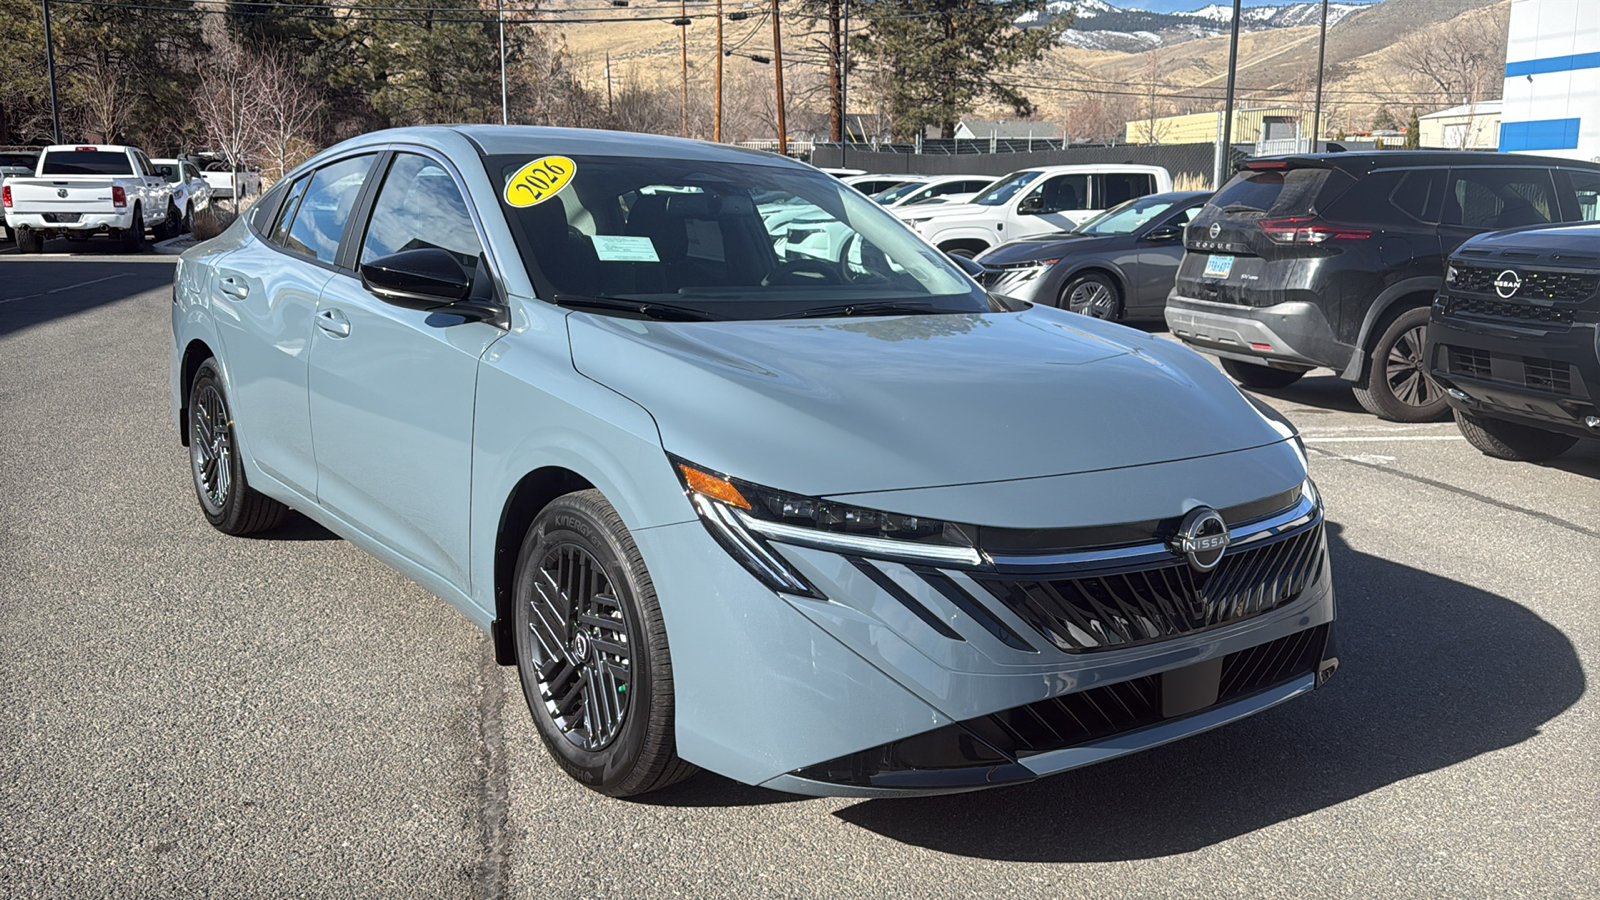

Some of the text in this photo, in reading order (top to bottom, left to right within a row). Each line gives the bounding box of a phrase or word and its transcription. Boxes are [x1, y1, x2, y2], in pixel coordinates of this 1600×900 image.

[516, 160, 566, 200] 2026
[554, 515, 593, 537] KINERGY
[1186, 535, 1230, 551] NISSAN
